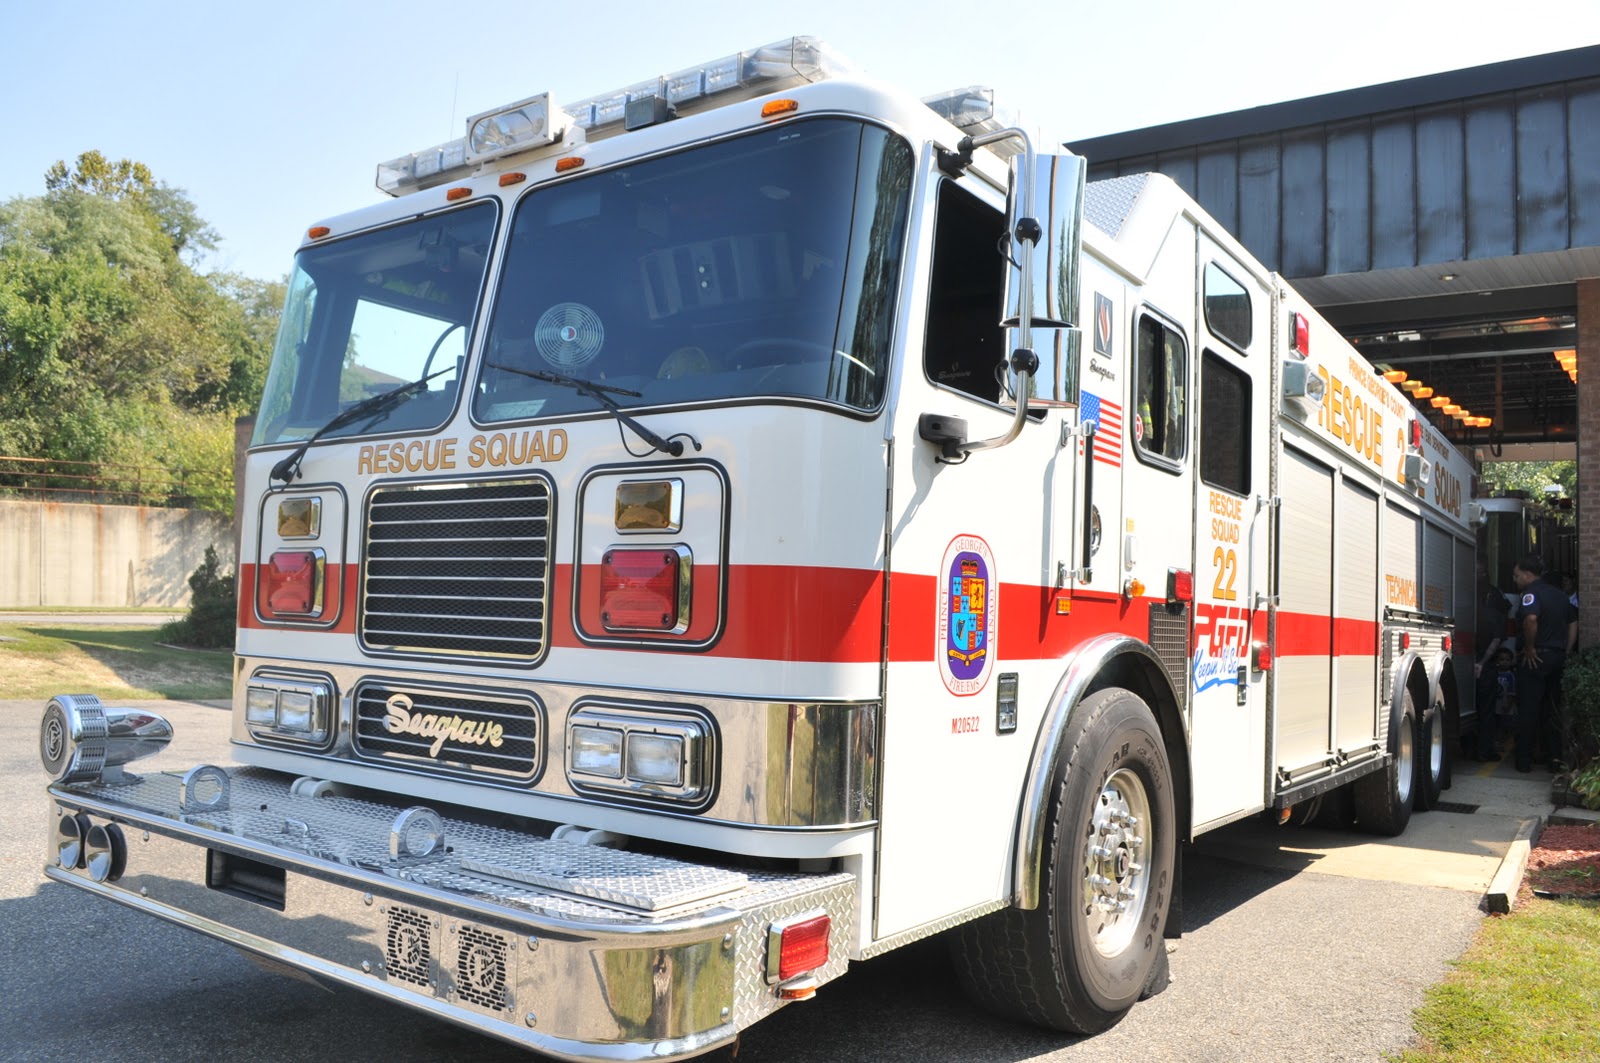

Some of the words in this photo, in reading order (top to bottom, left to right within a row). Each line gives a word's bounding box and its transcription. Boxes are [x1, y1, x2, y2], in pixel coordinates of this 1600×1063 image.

[358, 438, 458, 475] RESCUE
[468, 428, 568, 467] SQUAD
[1318, 364, 1382, 468] RESCUE
[1434, 461, 1460, 518] SQUAD
[1209, 491, 1242, 521] RESCUE
[955, 538, 988, 558] GEORGE'S
[1211, 518, 1240, 544] SQUAD
[1212, 546, 1237, 601] 22
[940, 587, 948, 640] PRINCE
[949, 676, 980, 693] FIRE/EMS
[382, 693, 504, 758] Seagrave
[951, 716, 979, 734] M20522
